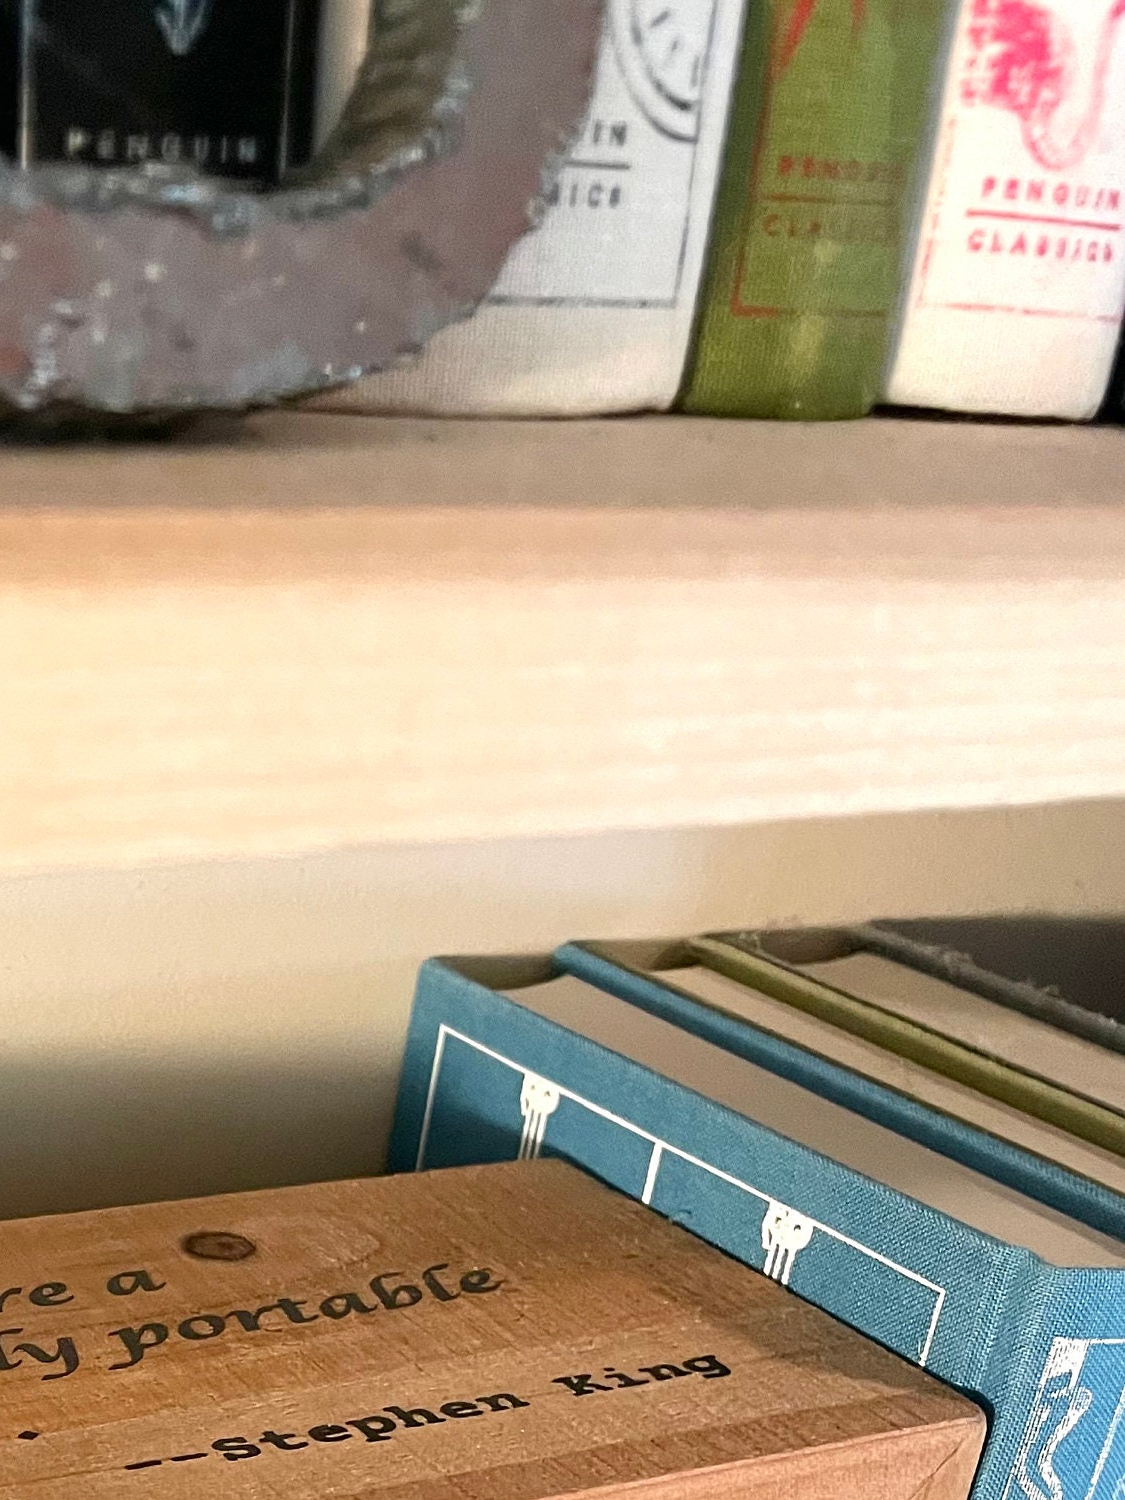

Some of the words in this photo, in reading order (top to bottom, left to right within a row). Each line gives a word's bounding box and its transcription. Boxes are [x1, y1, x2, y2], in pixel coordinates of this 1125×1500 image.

[65, 130, 259, 164] PENGUIN
[981, 175, 1122, 212] PENGUIN
[966, 228, 1115, 264] CLASSICS
[105, 1269, 166, 1296] a
[107, 1262, 504, 1371] portable
[553, 1352, 732, 1398] King
